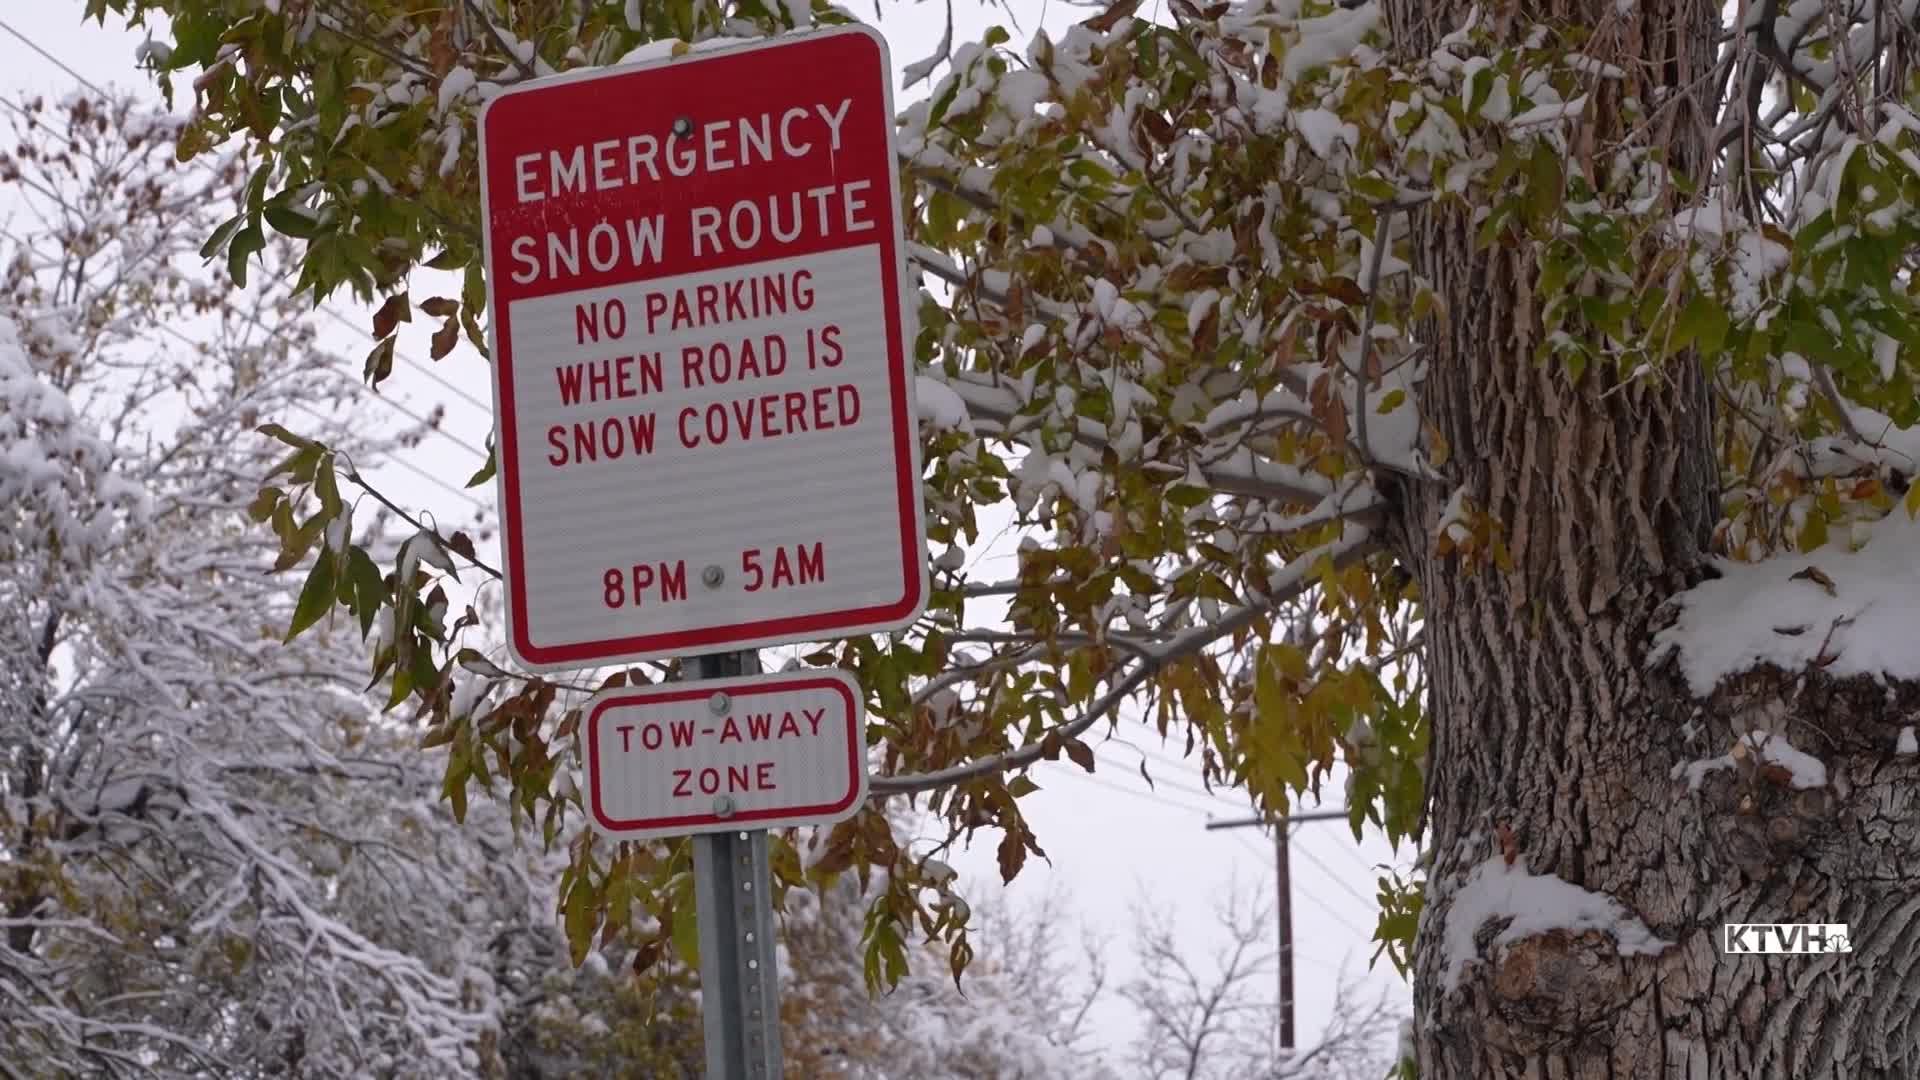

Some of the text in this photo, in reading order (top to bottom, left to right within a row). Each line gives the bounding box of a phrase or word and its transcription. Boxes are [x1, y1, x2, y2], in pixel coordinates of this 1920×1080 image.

[515, 98, 852, 203] EMERGENCY
[510, 179, 875, 285] SNOW ROUTE
[575, 269, 815, 345] NO PARKING
[556, 325, 843, 407] WHEN ROAD IS
[547, 384, 860, 467] SNOW COVERED
[603, 542, 825, 609] 8PM 5AM
[616, 708, 826, 753] TOW-AWAY
[672, 762, 777, 797] ZONE
